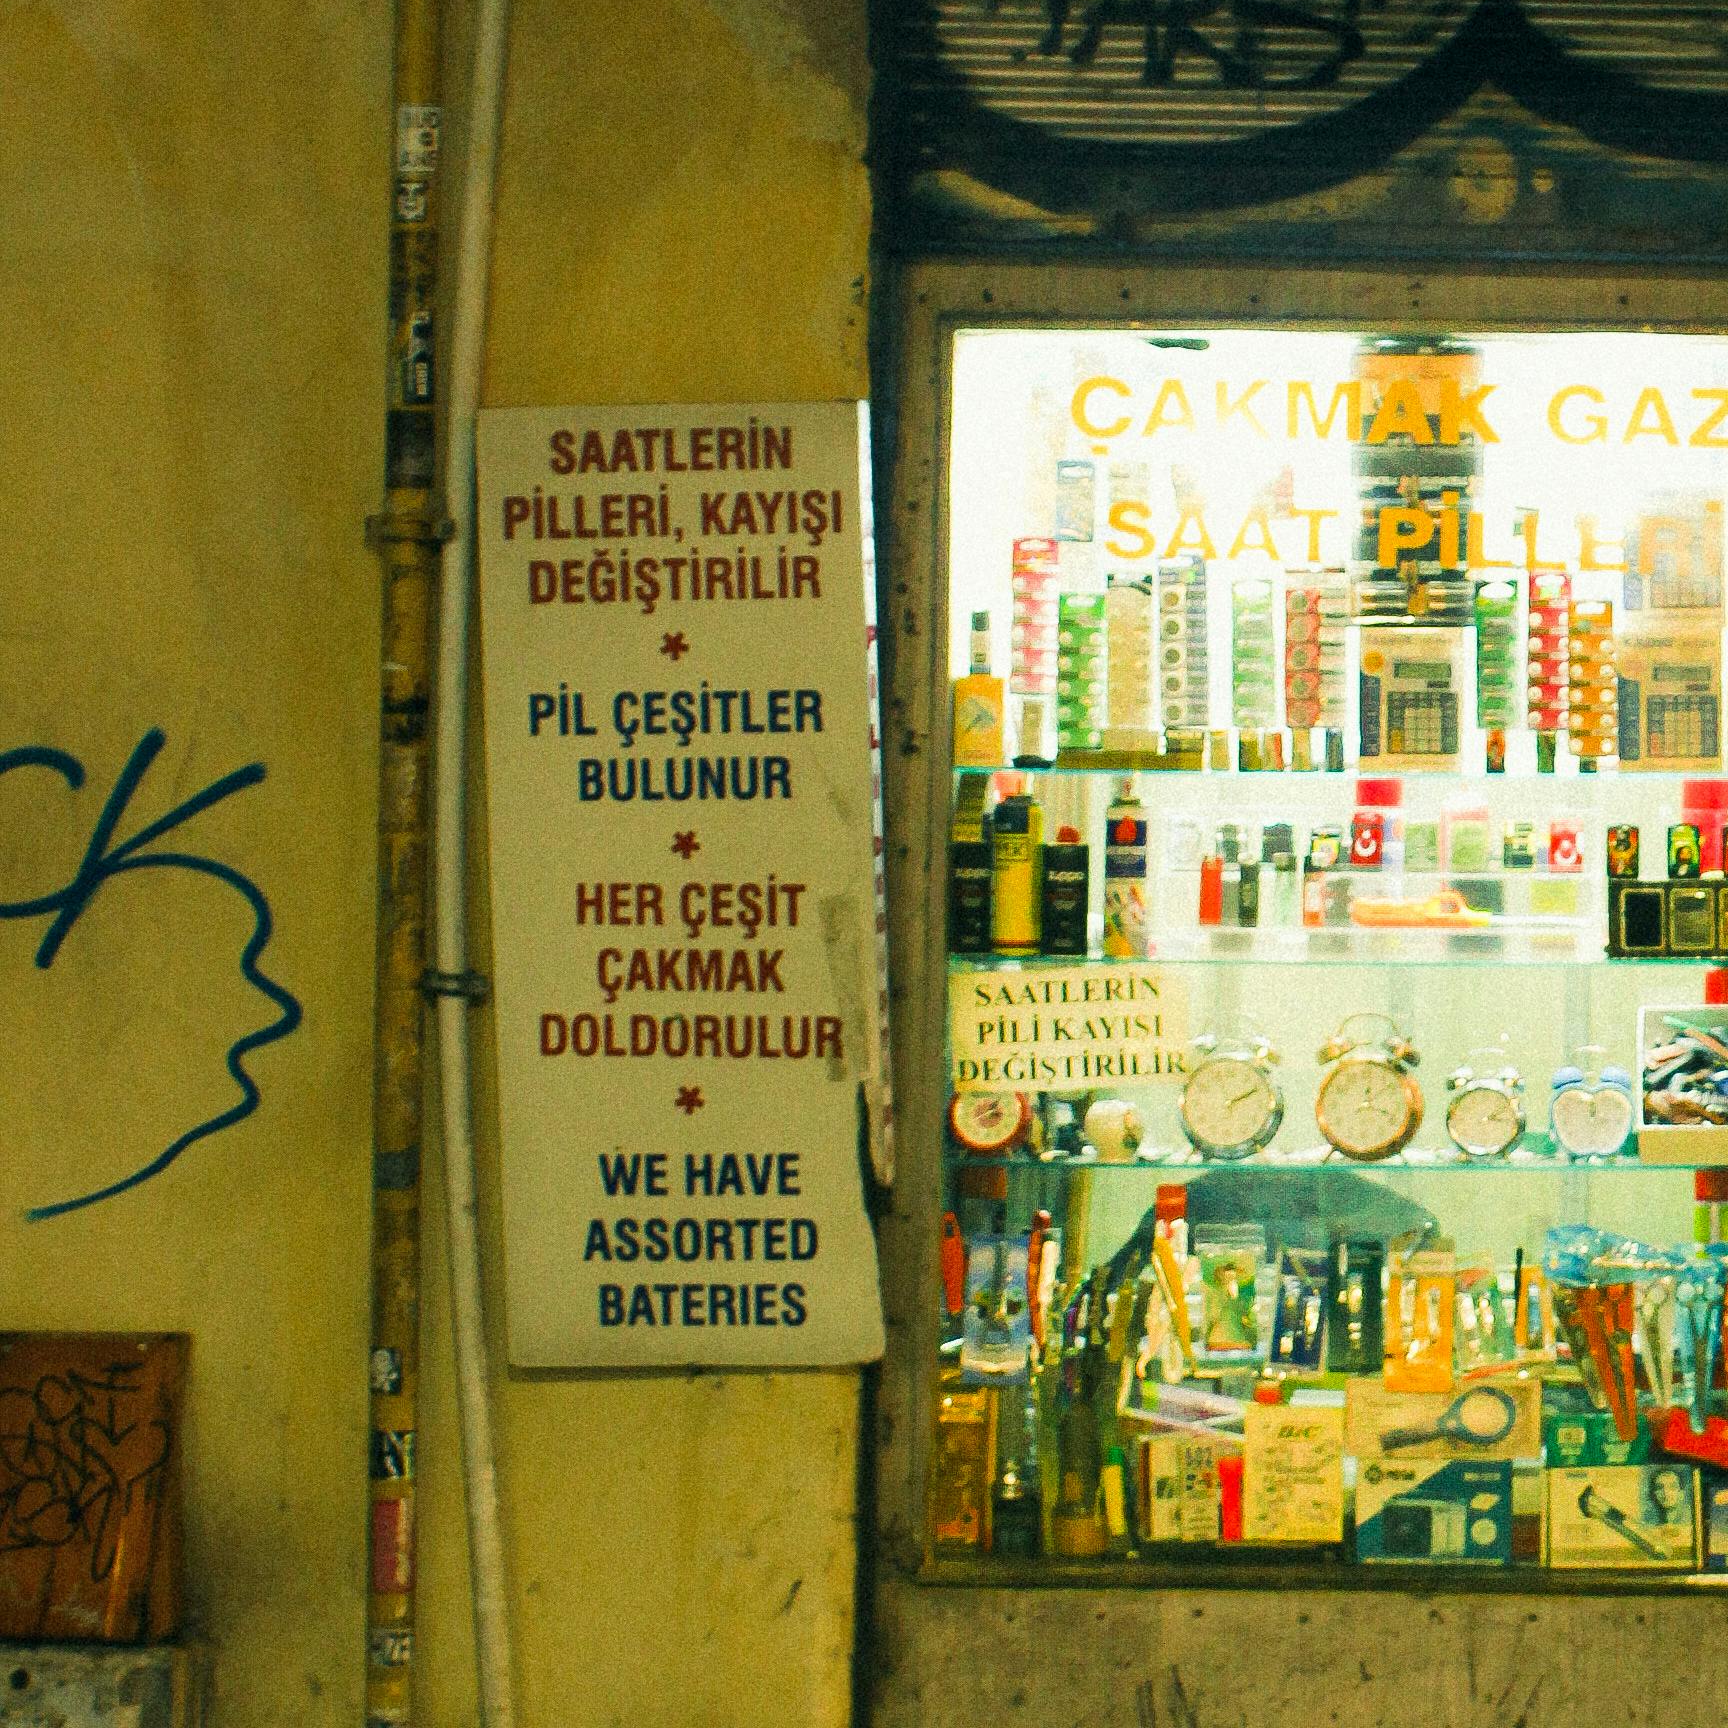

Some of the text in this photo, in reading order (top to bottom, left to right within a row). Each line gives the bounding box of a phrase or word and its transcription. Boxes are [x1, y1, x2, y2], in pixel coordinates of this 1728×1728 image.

[549, 416, 792, 475] SAATLERİN
[700, 489, 843, 546] KAYIŞI
[1105, 499, 1338, 562] SAAT
[528, 545, 821, 614] DEĞİŞTİRİLİR
[529, 681, 824, 748] PİL ÇEŞİTLER
[579, 756, 792, 803] BULUNUR
[576, 873, 806, 940] HER ÇEŞİT
[597, 947, 785, 1004] ÇAKMAK
[539, 1012, 844, 1059] DOLDORULUR
[598, 1153, 801, 1197] WE HAVE
[583, 1217, 819, 1263] ASSORTED
[598, 1283, 808, 1328] BATERIES
